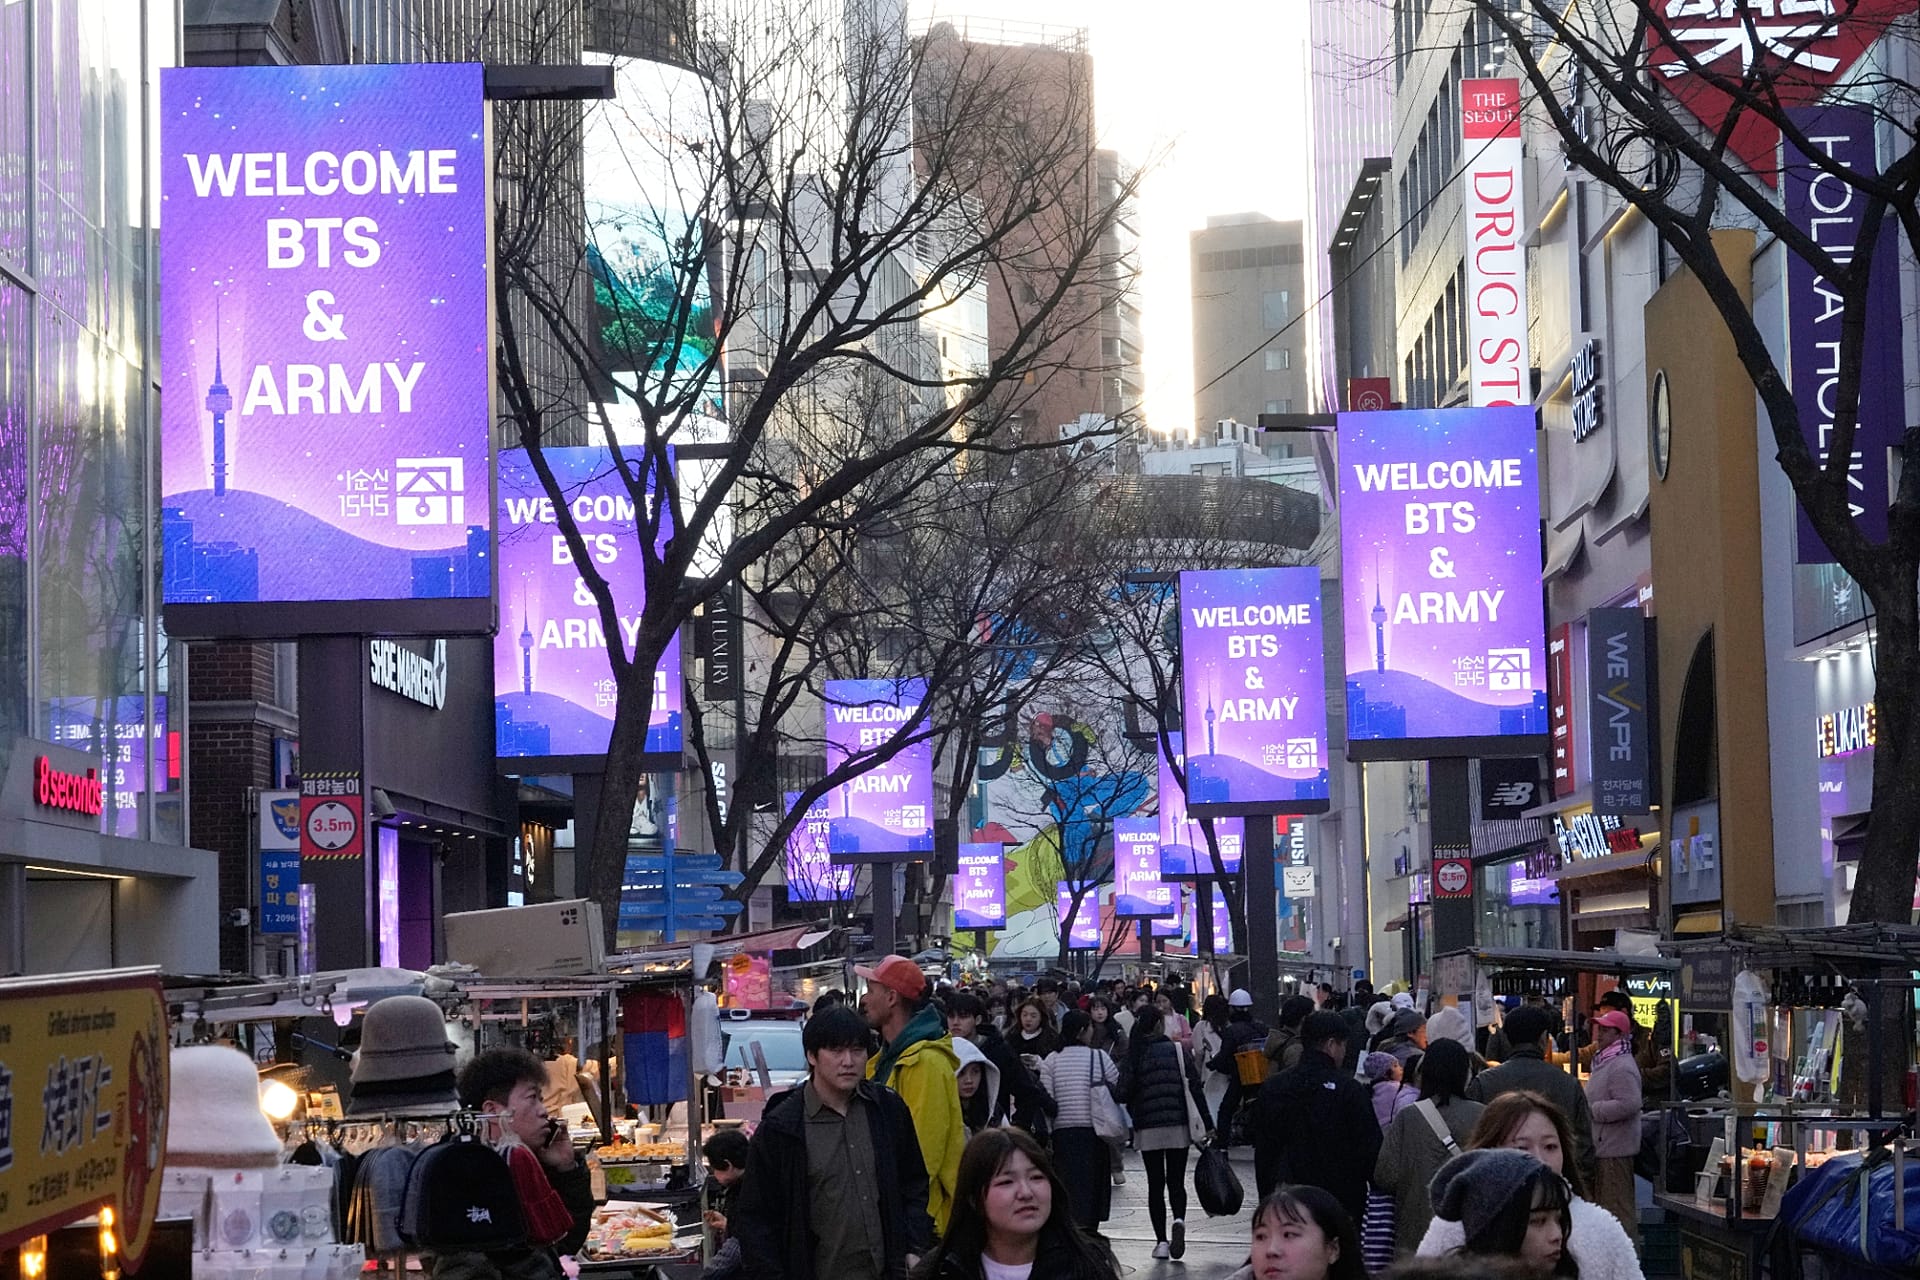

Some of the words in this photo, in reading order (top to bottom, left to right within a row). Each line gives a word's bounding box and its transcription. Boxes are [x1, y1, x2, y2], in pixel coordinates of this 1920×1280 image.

[1472, 92, 1507, 108] THE
[1464, 108, 1518, 124] SEOUL
[186, 150, 457, 197] WELCOME
[266, 217, 381, 269] BTS
[1473, 166, 1518, 320] DRUG
[302, 290, 347, 342] &
[1479, 338, 1521, 406] ST
[1571, 339, 1595, 396] DRUG
[241, 362, 425, 415] ARMY
[1572, 388, 1598, 444] STORE
[1353, 459, 1522, 492] WELCOME
[338, 494, 389, 517] 1545
[1405, 501, 1476, 535] BTS
[1428, 546, 1456, 579] &
[1192, 604, 1311, 628] WELCOME
[1393, 590, 1505, 624] ARMY
[712, 620, 728, 685] LUXURY
[1228, 634, 1278, 659] BTS
[370, 640, 397, 692] SHOE
[397, 645, 434, 708] MARKER
[1244, 666, 1265, 690] &
[1219, 697, 1299, 723] ARMY
[302, 779, 360, 796] 제한높이
[853, 774, 912, 793] ARMY
[313, 817, 353, 832] 3.5m
[958, 855, 999, 865] WELCOME
[1133, 844, 1155, 856] BTS
[969, 866, 988, 876] BTS
[1140, 857, 1149, 868] &
[975, 877, 984, 887] &
[1129, 871, 1161, 882] ARMY
[1441, 872, 1466, 881] 3.5m
[966, 889, 995, 898] ARMY
